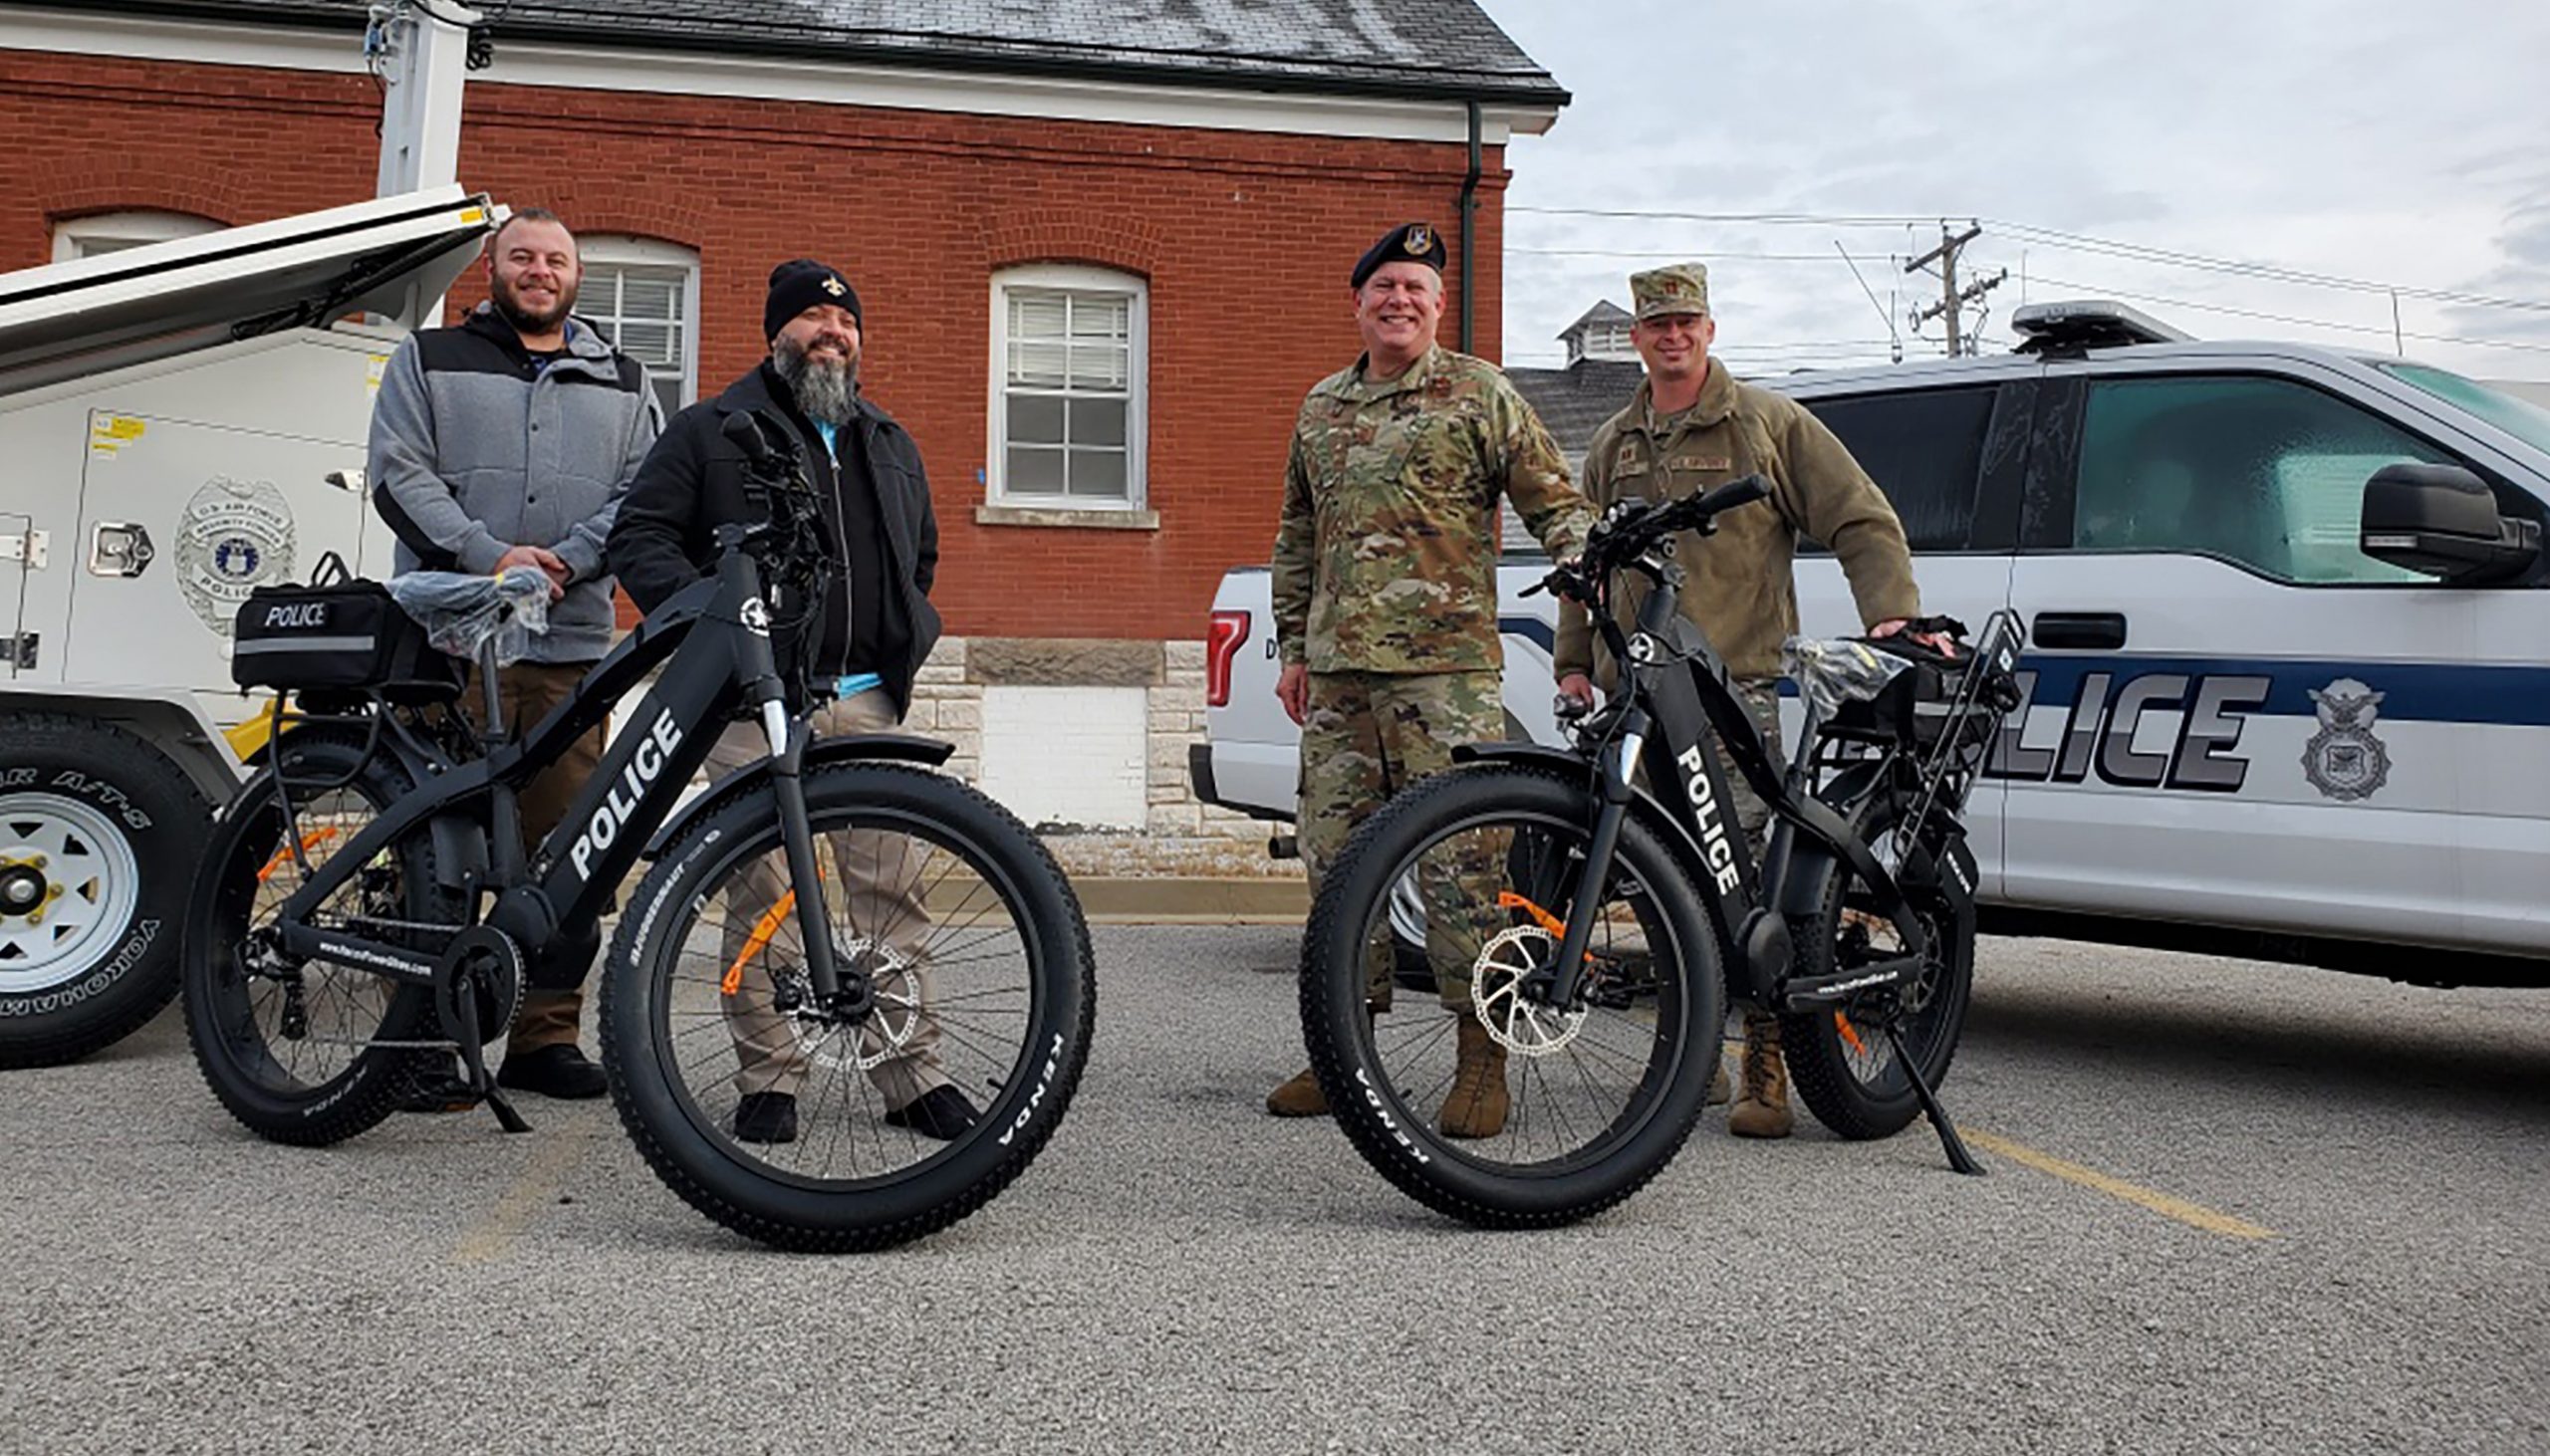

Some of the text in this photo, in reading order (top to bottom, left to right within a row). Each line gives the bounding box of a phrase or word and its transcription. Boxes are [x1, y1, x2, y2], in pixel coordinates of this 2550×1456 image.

[246, 504, 282, 525] FORCE
[200, 576, 252, 598] POLIC
[264, 603, 326, 627] POLICE
[1980, 670, 2272, 794] LICE
[570, 706, 683, 882] POLICE
[1677, 744, 1740, 896] POLICE
[0, 919, 160, 1017] YOKOHAM
[997, 1032, 1065, 1146] KENDA
[1355, 1067, 1430, 1165] KENDA
